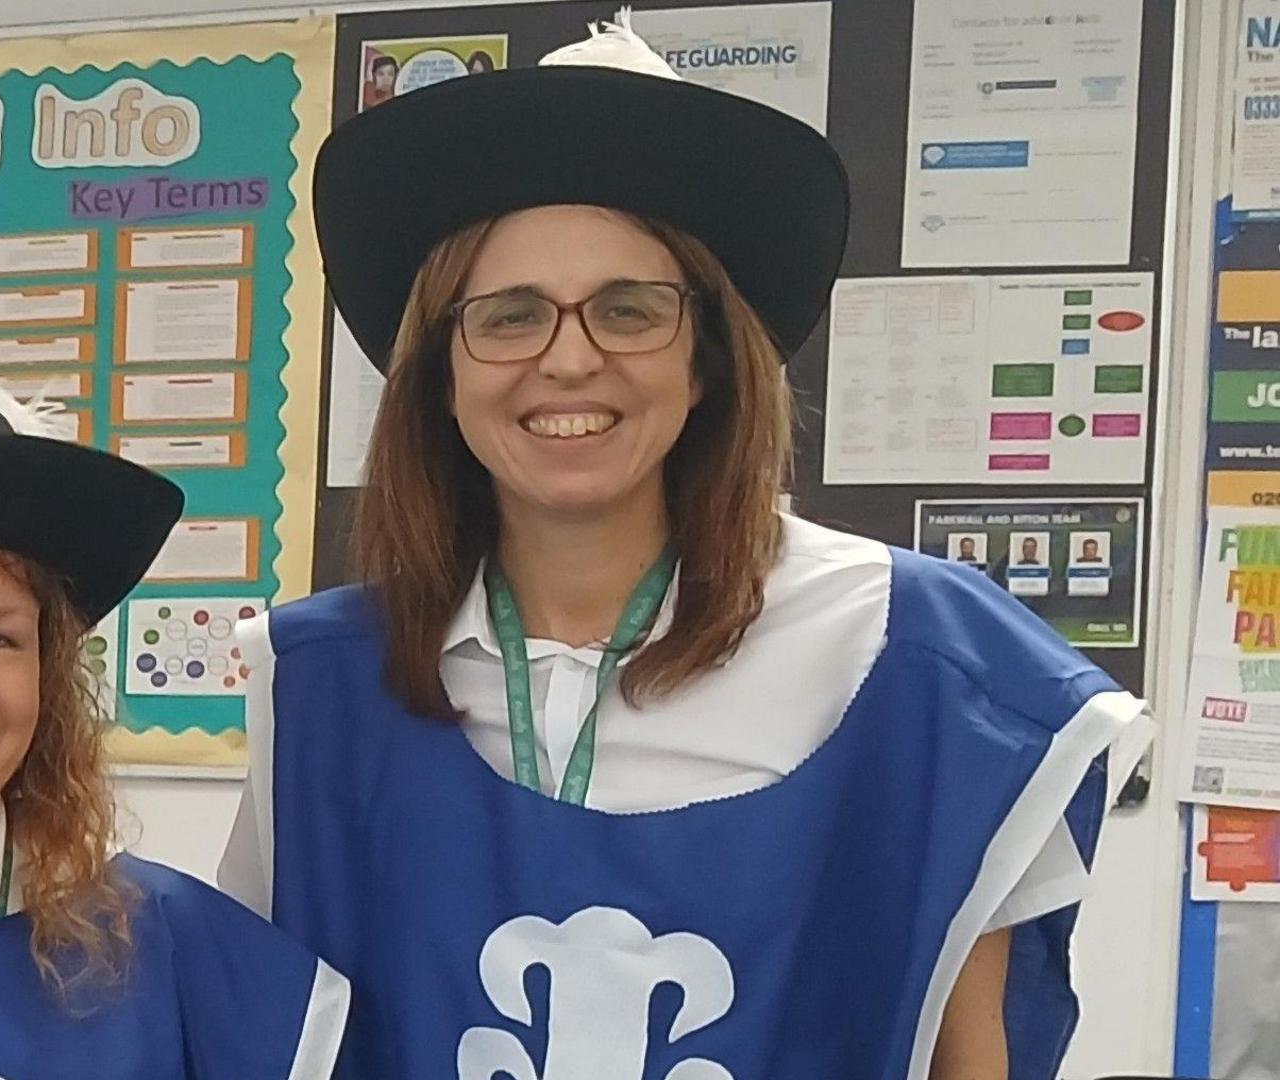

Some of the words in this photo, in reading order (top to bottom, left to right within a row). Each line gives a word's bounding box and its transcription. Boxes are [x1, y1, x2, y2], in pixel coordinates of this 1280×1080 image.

[658, 45, 798, 69] FEGUARDING
[39, 87, 191, 159] Info
[71, 180, 135, 219] Key
[146, 176, 264, 210] Terms
[1204, 699, 1245, 722] VOTE
